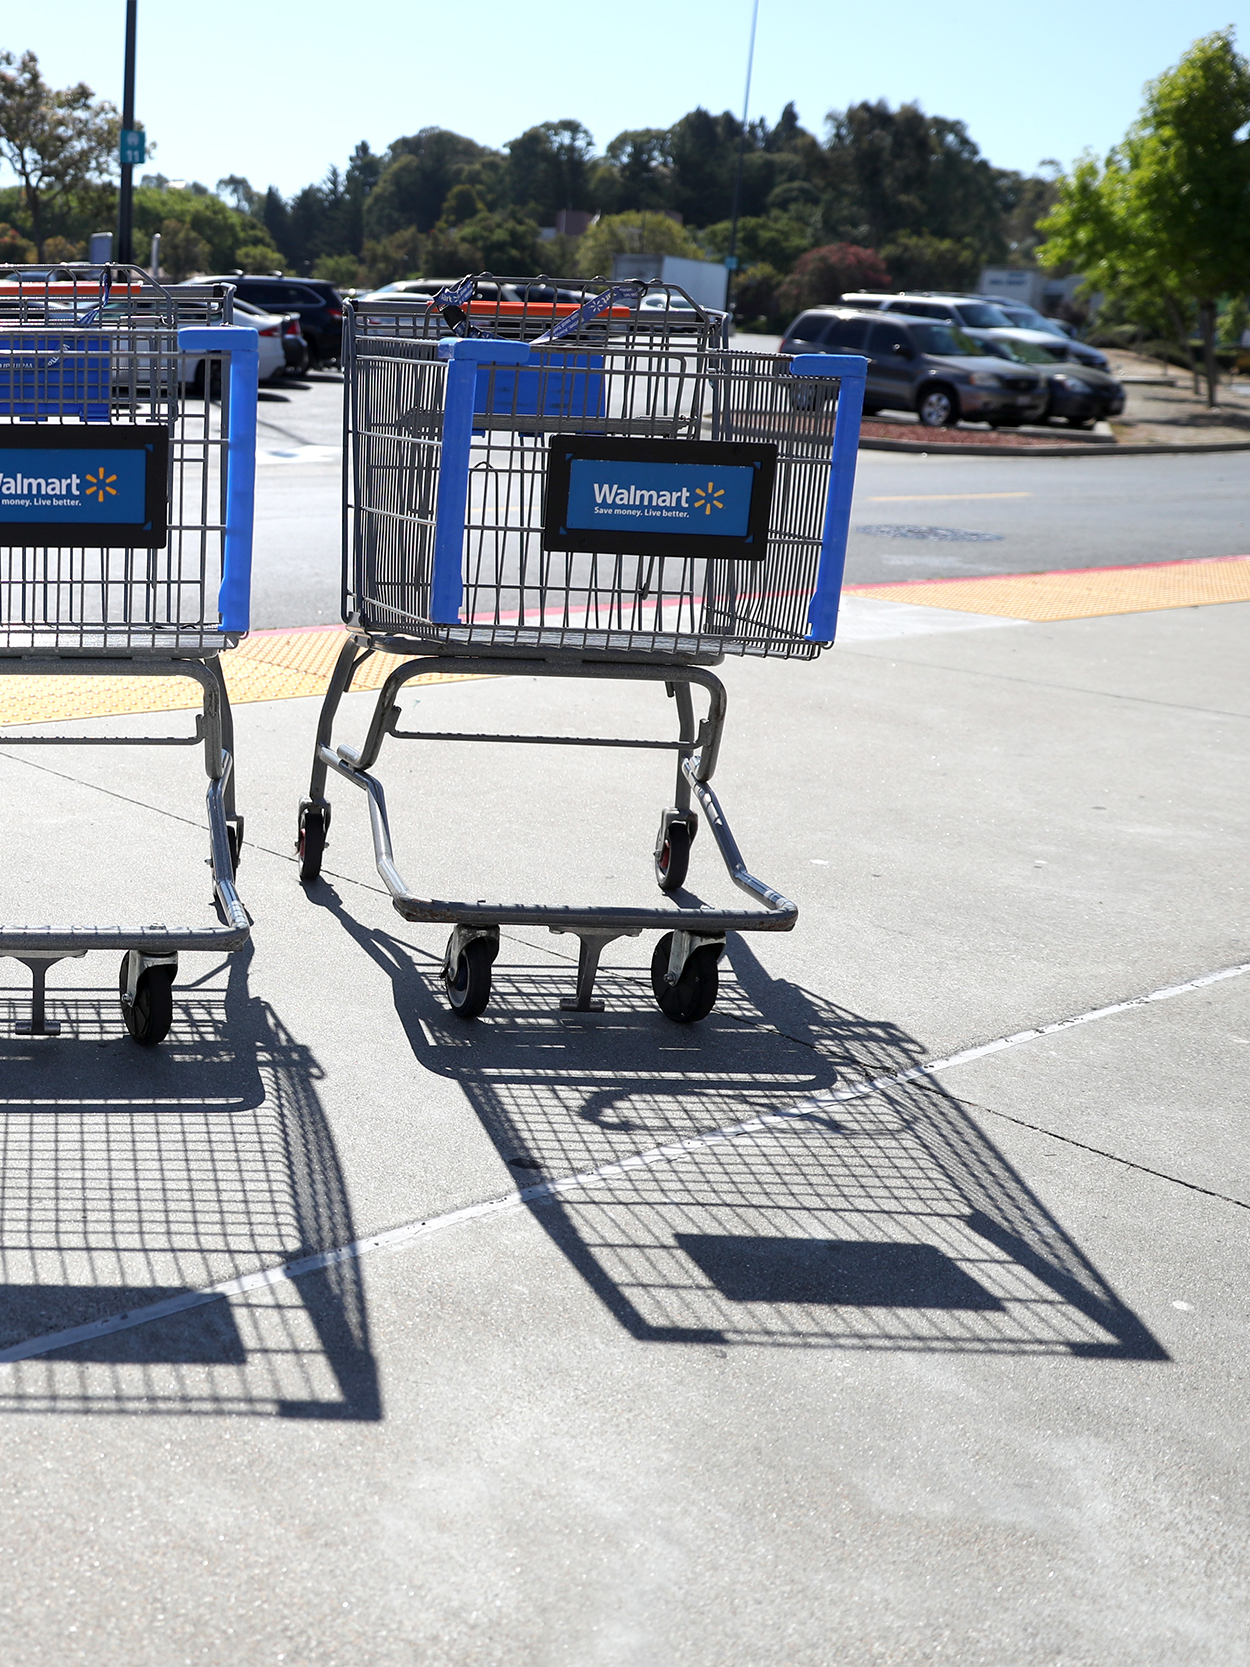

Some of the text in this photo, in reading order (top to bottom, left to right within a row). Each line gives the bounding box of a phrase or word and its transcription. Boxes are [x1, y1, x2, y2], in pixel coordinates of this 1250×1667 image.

[593, 483, 691, 508] Walmart
[1, 498, 33, 508] money.
[33, 497, 52, 506] Live
[52, 497, 82, 507] better.
[594, 506, 690, 519] Save money. Live better.
